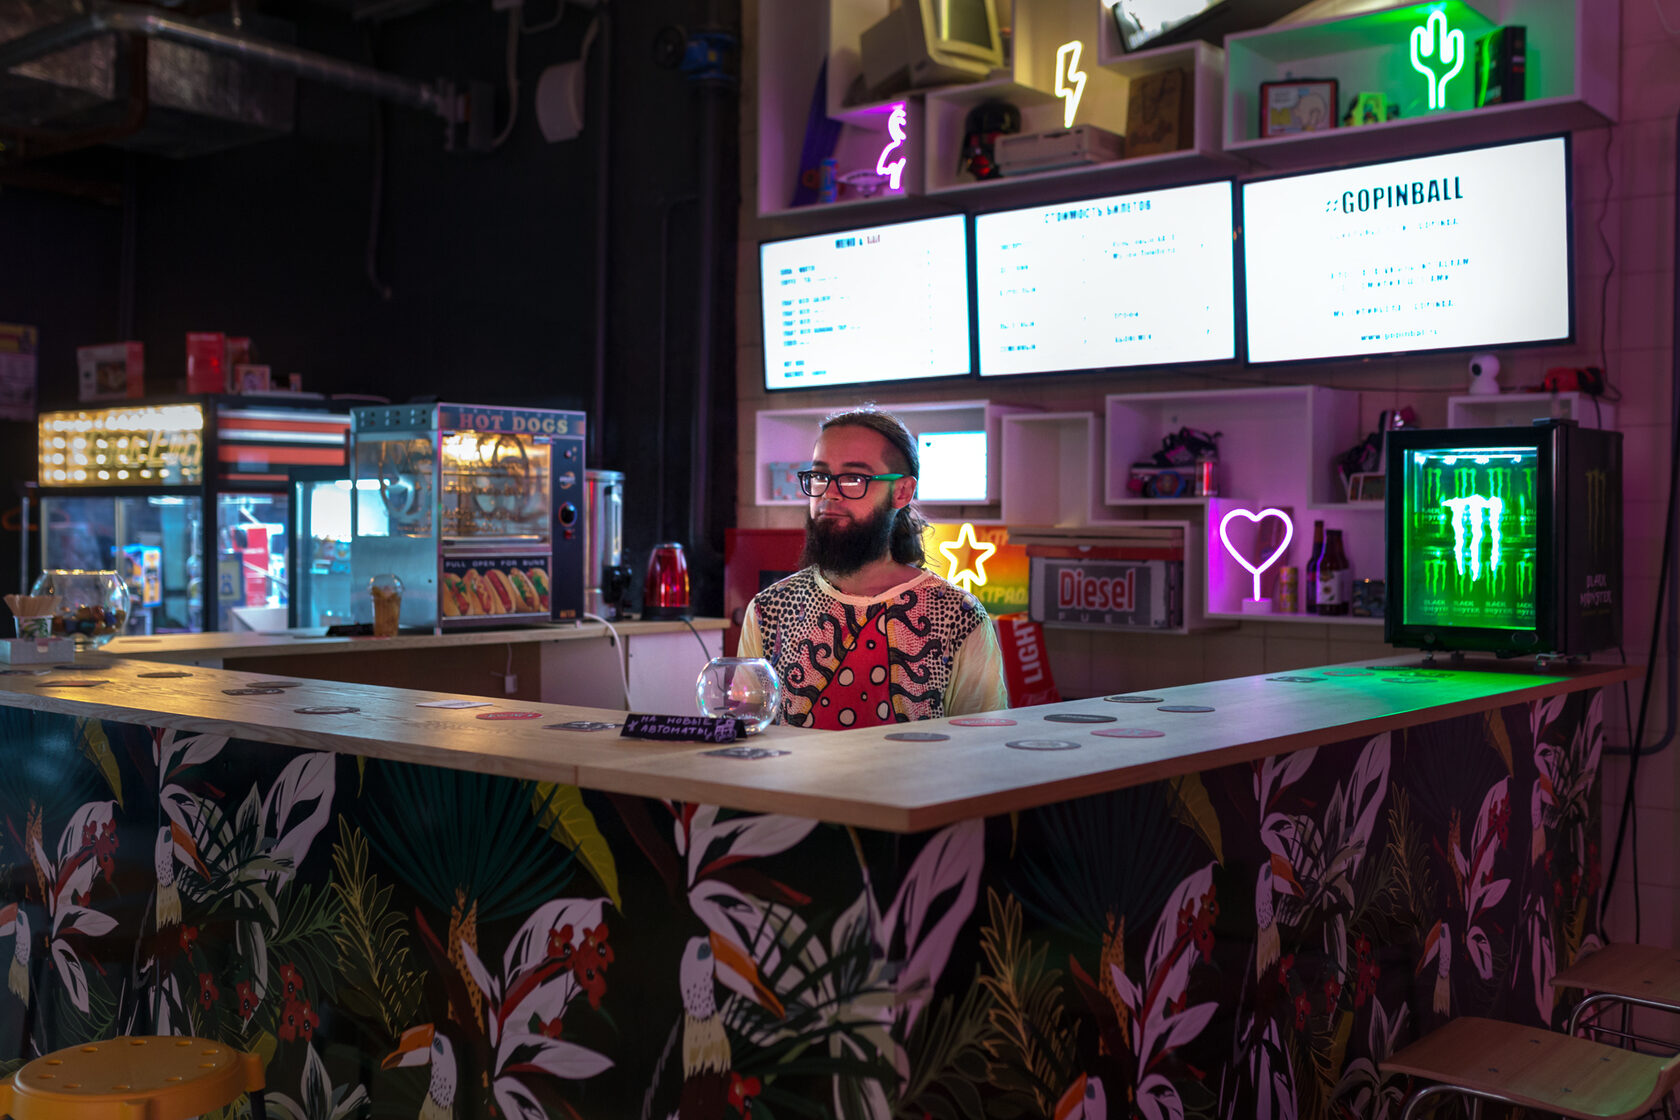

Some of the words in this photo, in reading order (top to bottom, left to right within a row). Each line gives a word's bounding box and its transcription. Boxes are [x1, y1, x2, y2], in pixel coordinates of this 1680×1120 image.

[1325, 176, 1463, 214] #GOPINBALL
[459, 413, 504, 431] HOT
[512, 416, 569, 434] DOGS
[445, 560, 467, 568] PULL
[500, 559, 518, 567] FOR
[1058, 567, 1136, 612] Diesel
[640, 715, 657, 723] НА
[666, 717, 713, 726] НОВЫЕ
